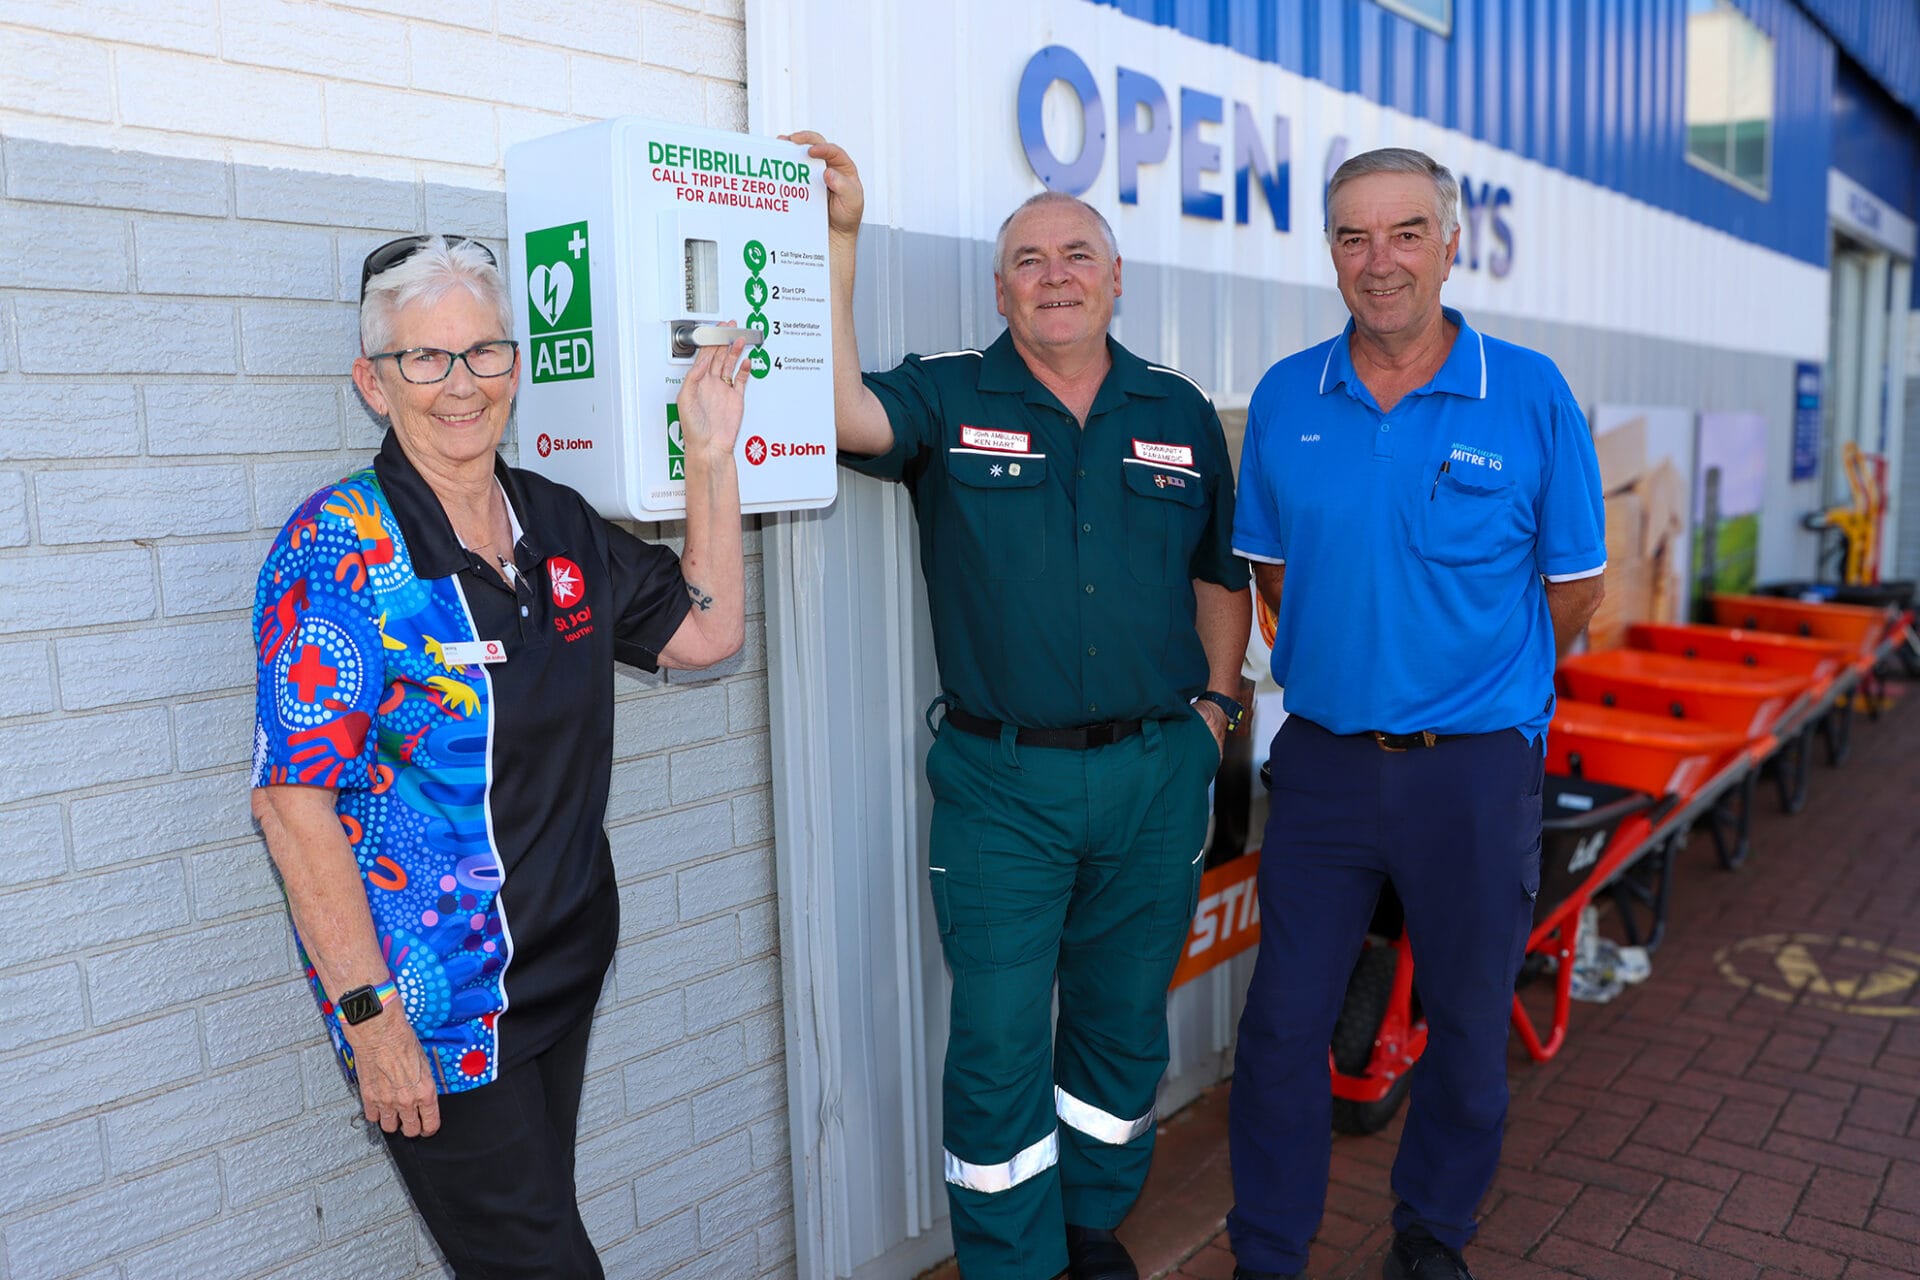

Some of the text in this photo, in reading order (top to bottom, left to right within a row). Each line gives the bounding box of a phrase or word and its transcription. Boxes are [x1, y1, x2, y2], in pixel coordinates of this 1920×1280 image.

[1018, 44, 1291, 233] OPEN
[648, 141, 811, 184] DEFIBRILLATOR
[652, 167, 809, 201] CALL TRIPLE ZERO (000)
[676, 187, 789, 212] FOR AMBULANCE
[770, 250, 776, 264] 1
[772, 285, 780, 300] 2
[781, 286, 794, 294] Start
[773, 321, 781, 335] 3
[535, 337, 591, 377] AED
[774, 356, 782, 370] 4
[665, 376, 681, 384] Press
[553, 438, 593, 451] St John
[974, 438, 1015, 448] KEN HART
[990, 432, 1026, 442] AMBULANCE
[770, 442, 826, 457] St John
[1450, 449, 1502, 471] MITRE 10
[1188, 876, 1260, 958] STI
